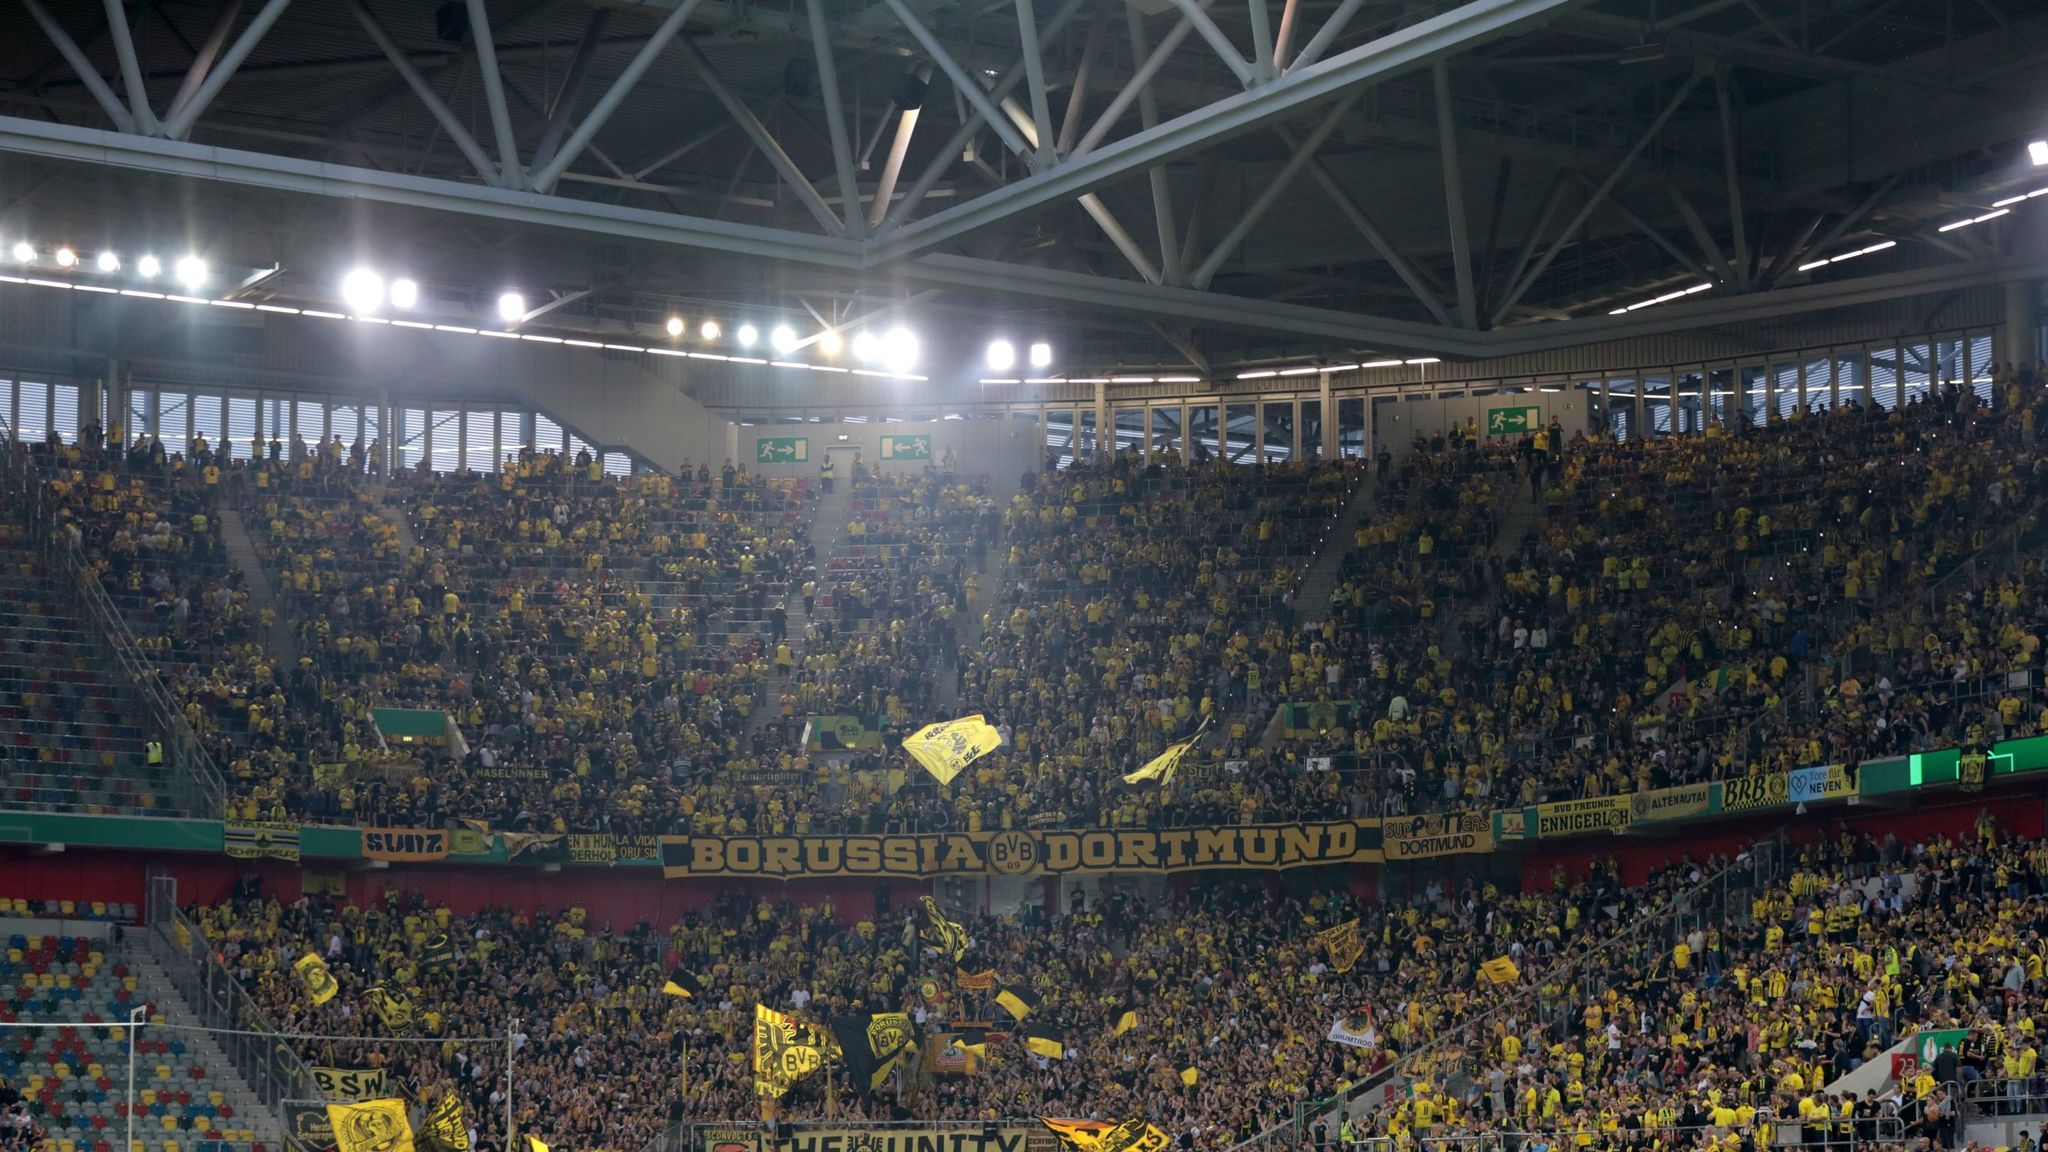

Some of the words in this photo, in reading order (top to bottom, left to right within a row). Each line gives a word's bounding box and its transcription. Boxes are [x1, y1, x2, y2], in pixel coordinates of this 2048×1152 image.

[1809, 770, 1827, 781] Tore
[1724, 776, 1767, 807] BRB
[1809, 780, 1842, 794] NEVEN
[1554, 803, 1572, 813] BVB
[1574, 799, 1616, 812] FREUNDE
[633, 834, 656, 846] VIDA
[995, 834, 1033, 862] BVB
[1044, 823, 1358, 870] DORTMUND
[1400, 835, 1476, 855] DORTMUND
[690, 834, 986, 873] BORUSSIA
[1007, 861, 1021, 870] 09
[786, 1047, 820, 1072] BVB
[1899, 1057, 1915, 1077] 23
[314, 1070, 384, 1096] BSW
